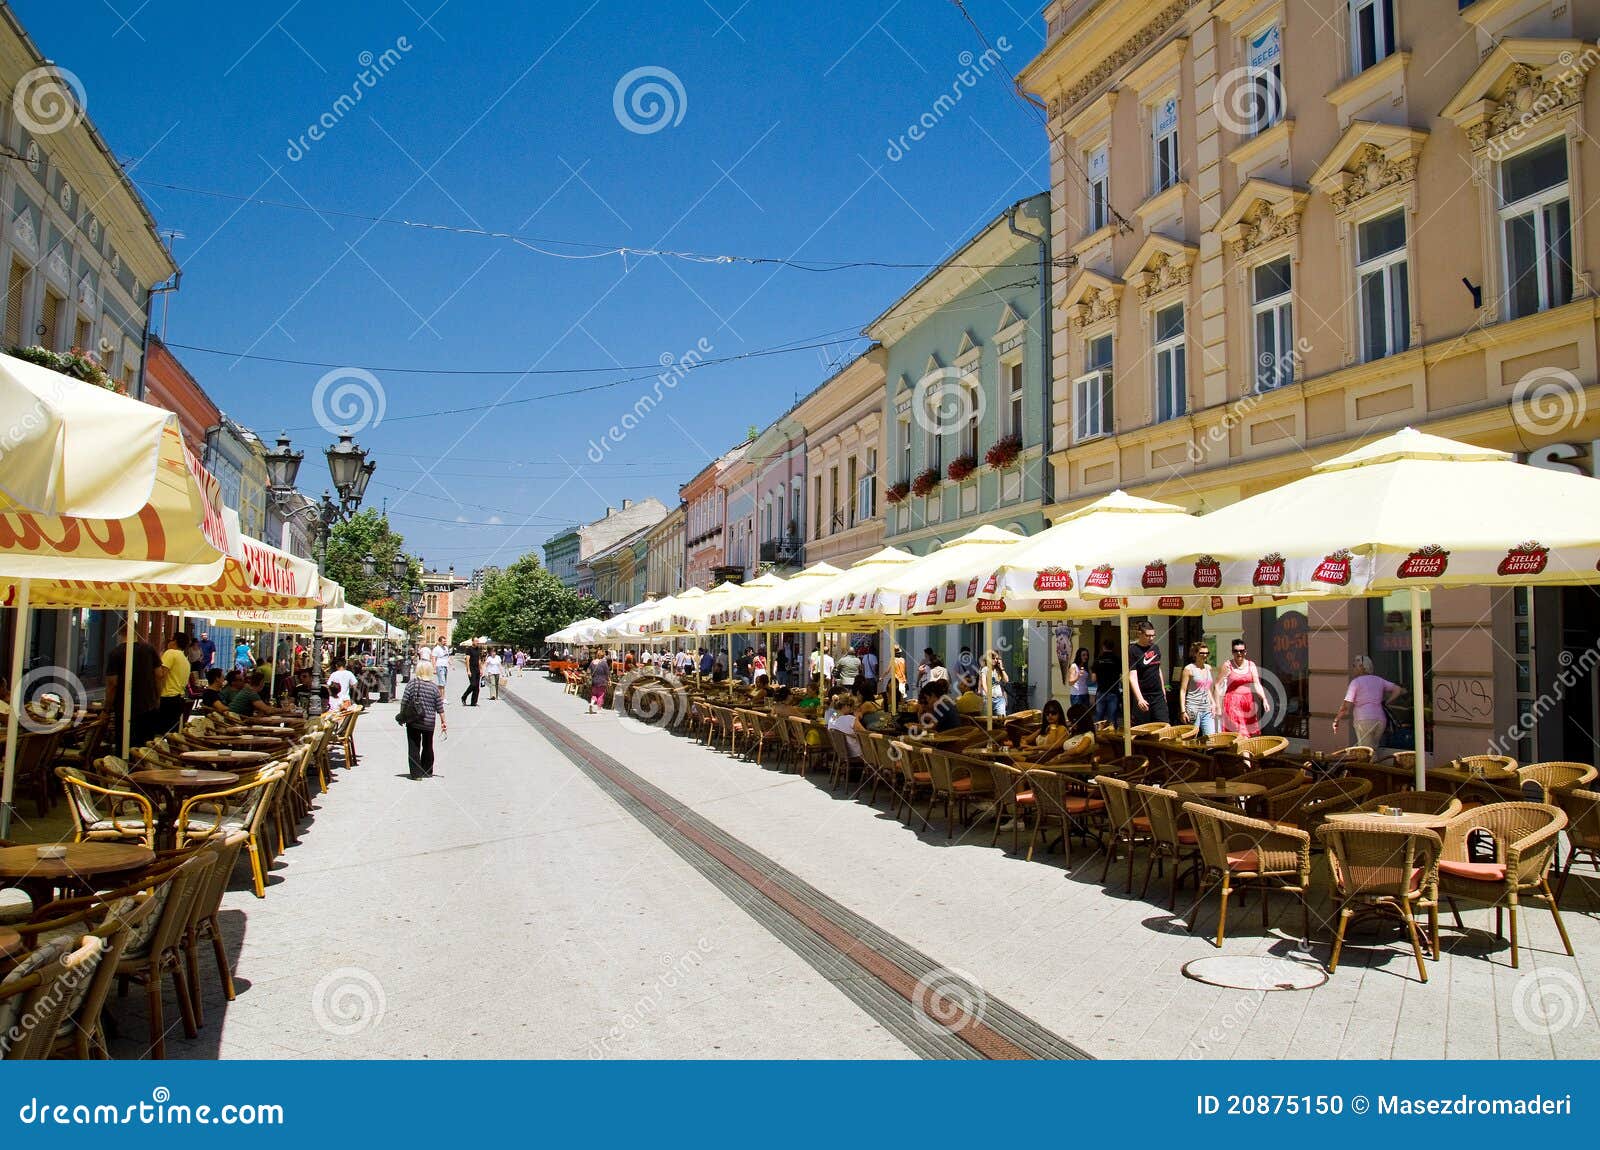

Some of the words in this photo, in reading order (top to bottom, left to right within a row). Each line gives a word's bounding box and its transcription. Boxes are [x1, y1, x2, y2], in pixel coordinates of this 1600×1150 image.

[1410, 558, 1441, 566] STELLA
[1510, 555, 1541, 563] STELLA
[1260, 566, 1281, 574] STELLA
[1322, 562, 1346, 571] STELLA
[1406, 565, 1438, 573] ARTOIS
[1506, 562, 1539, 570] ARTOIS
[1198, 568, 1217, 576] STELLA
[1318, 570, 1344, 580] ARTOIS
[1258, 573, 1280, 581] ARTOIS
